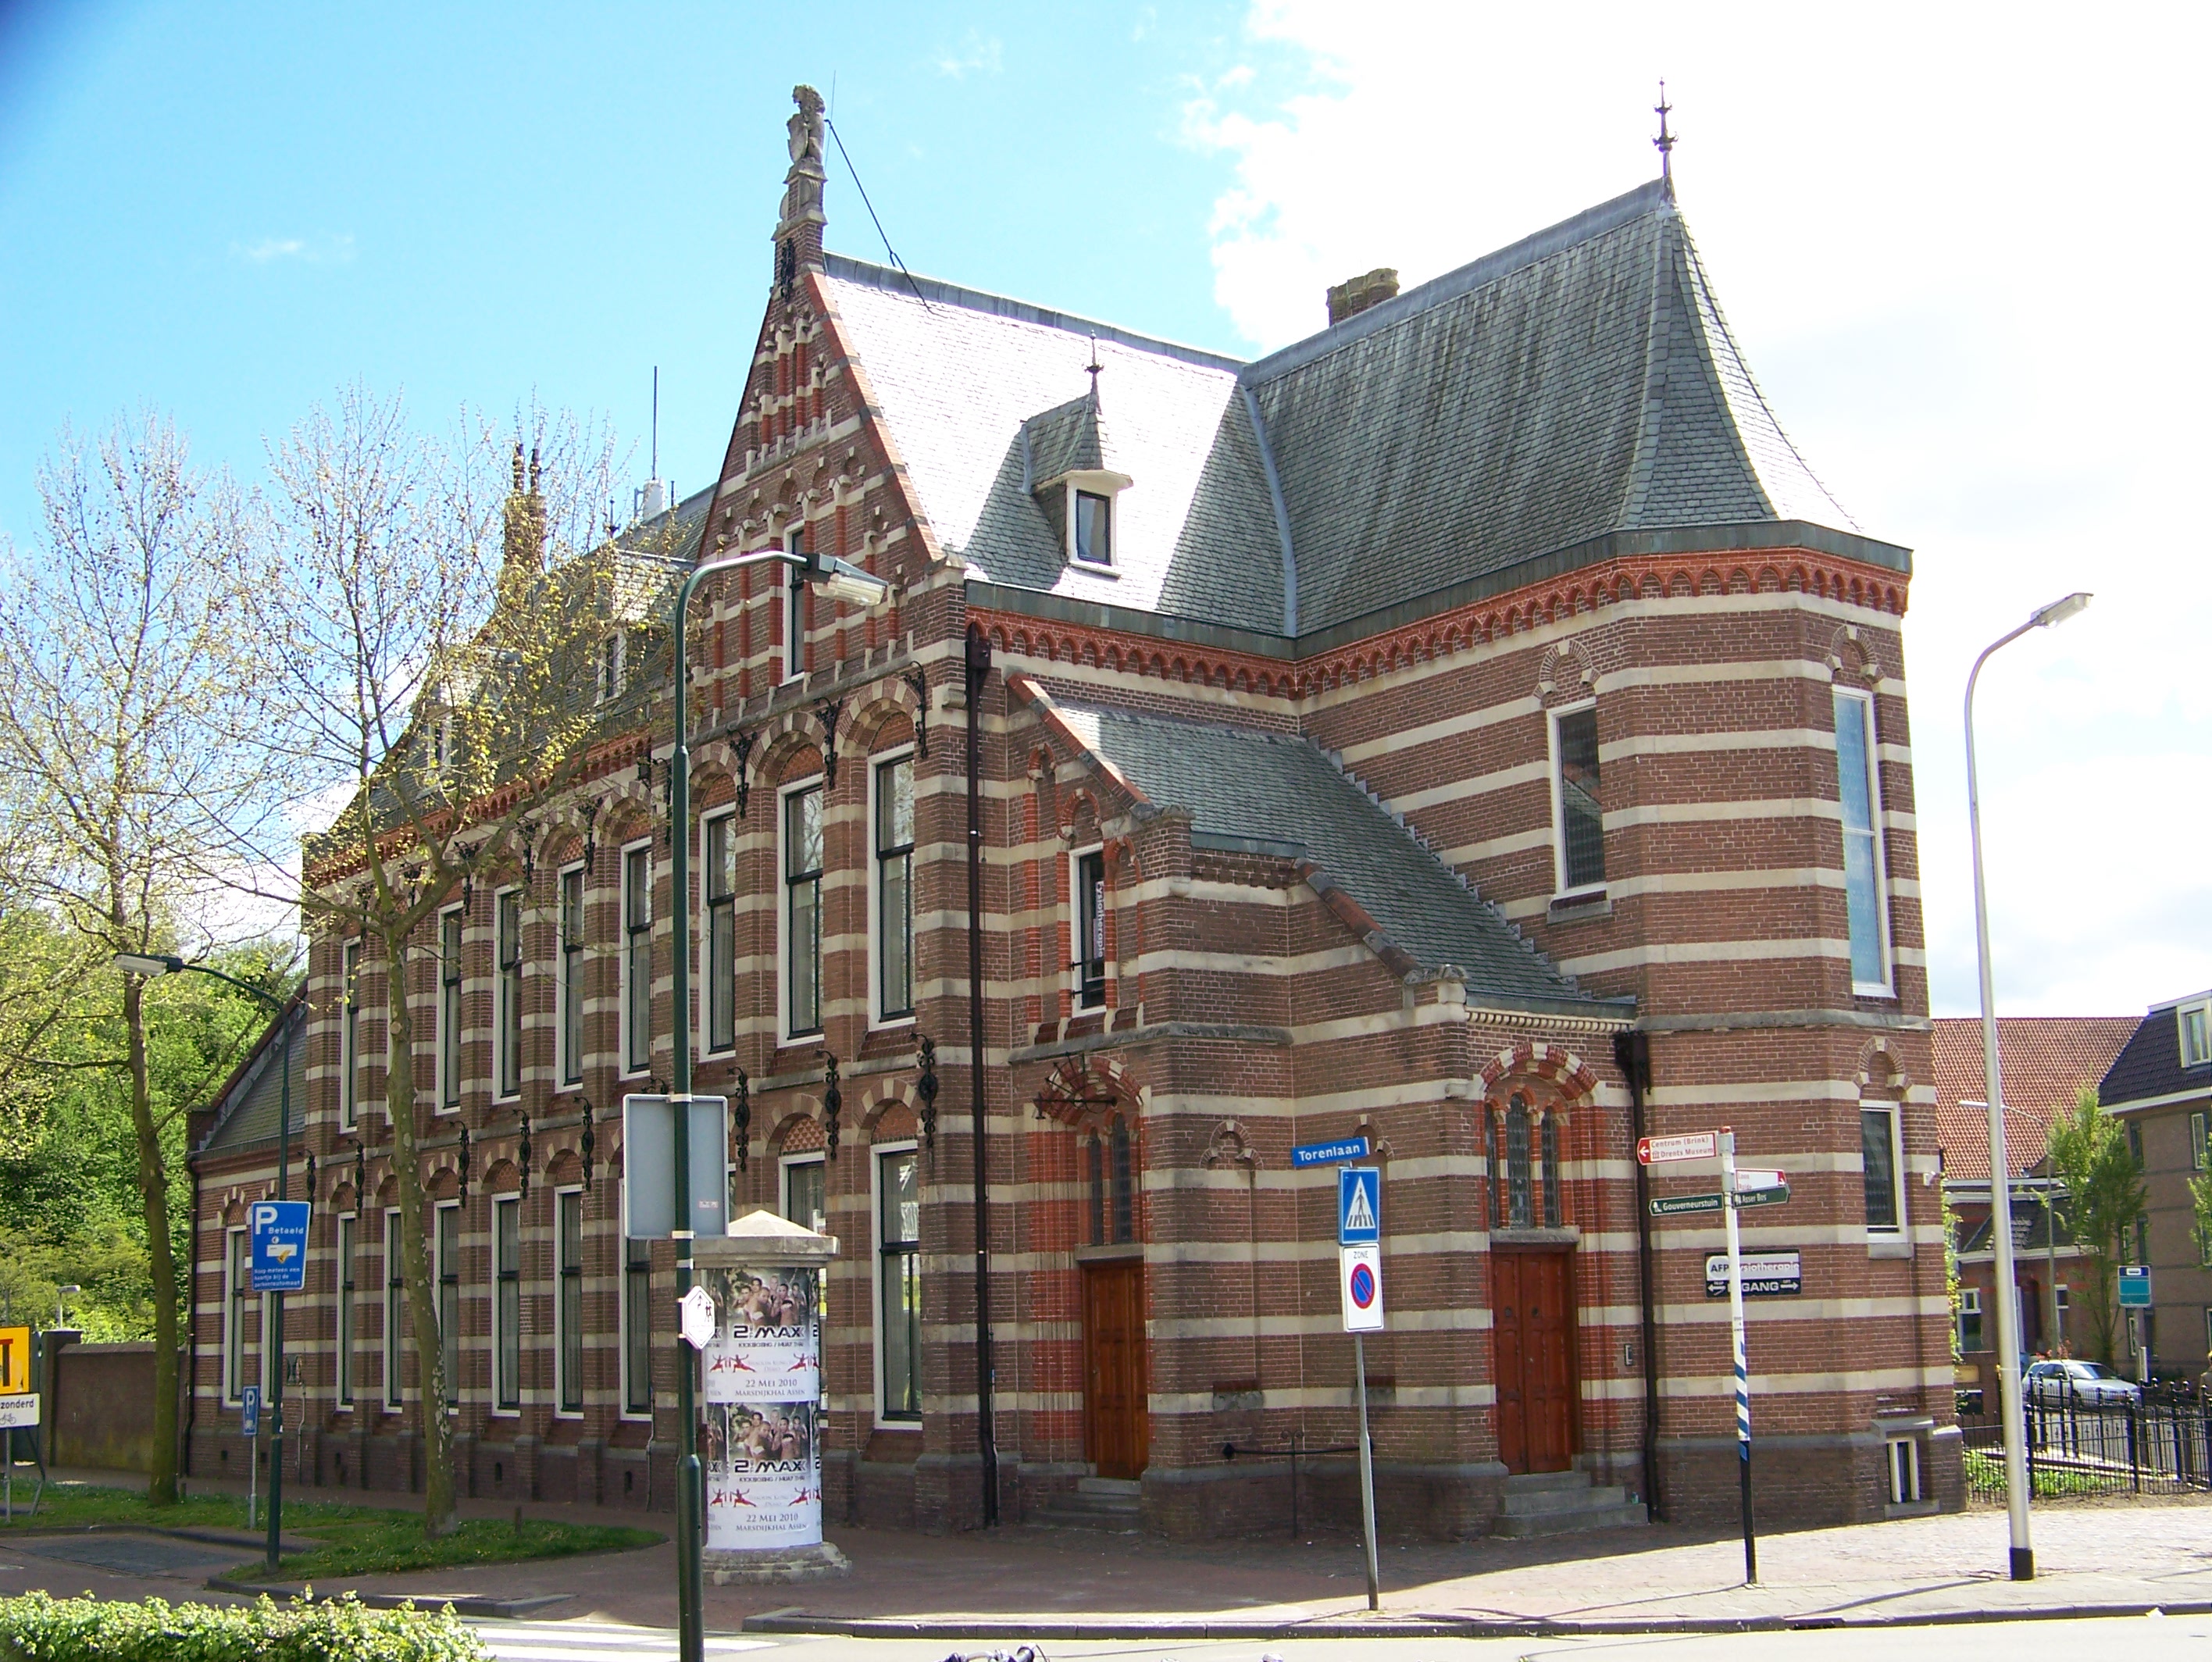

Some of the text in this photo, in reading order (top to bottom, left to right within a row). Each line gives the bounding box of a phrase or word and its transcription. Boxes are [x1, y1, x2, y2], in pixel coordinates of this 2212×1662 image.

[1650, 1136, 1709, 1148] Centrum (Brink)
[1298, 1144, 1361, 1161] Torenlaan
[1662, 1199, 1718, 1211] Gouverneurstuin
[255, 1207, 278, 1234] P
[1354, 1250, 1368, 1259] ZONE
[1711, 1261, 1800, 1272] AFP ysiotherapie
[1728, 1282, 1779, 1293] IGANG
[779, 1378, 797, 1387] 2010
[247, 1390, 255, 1414] P
[780, 1513, 798, 1521] 2010
